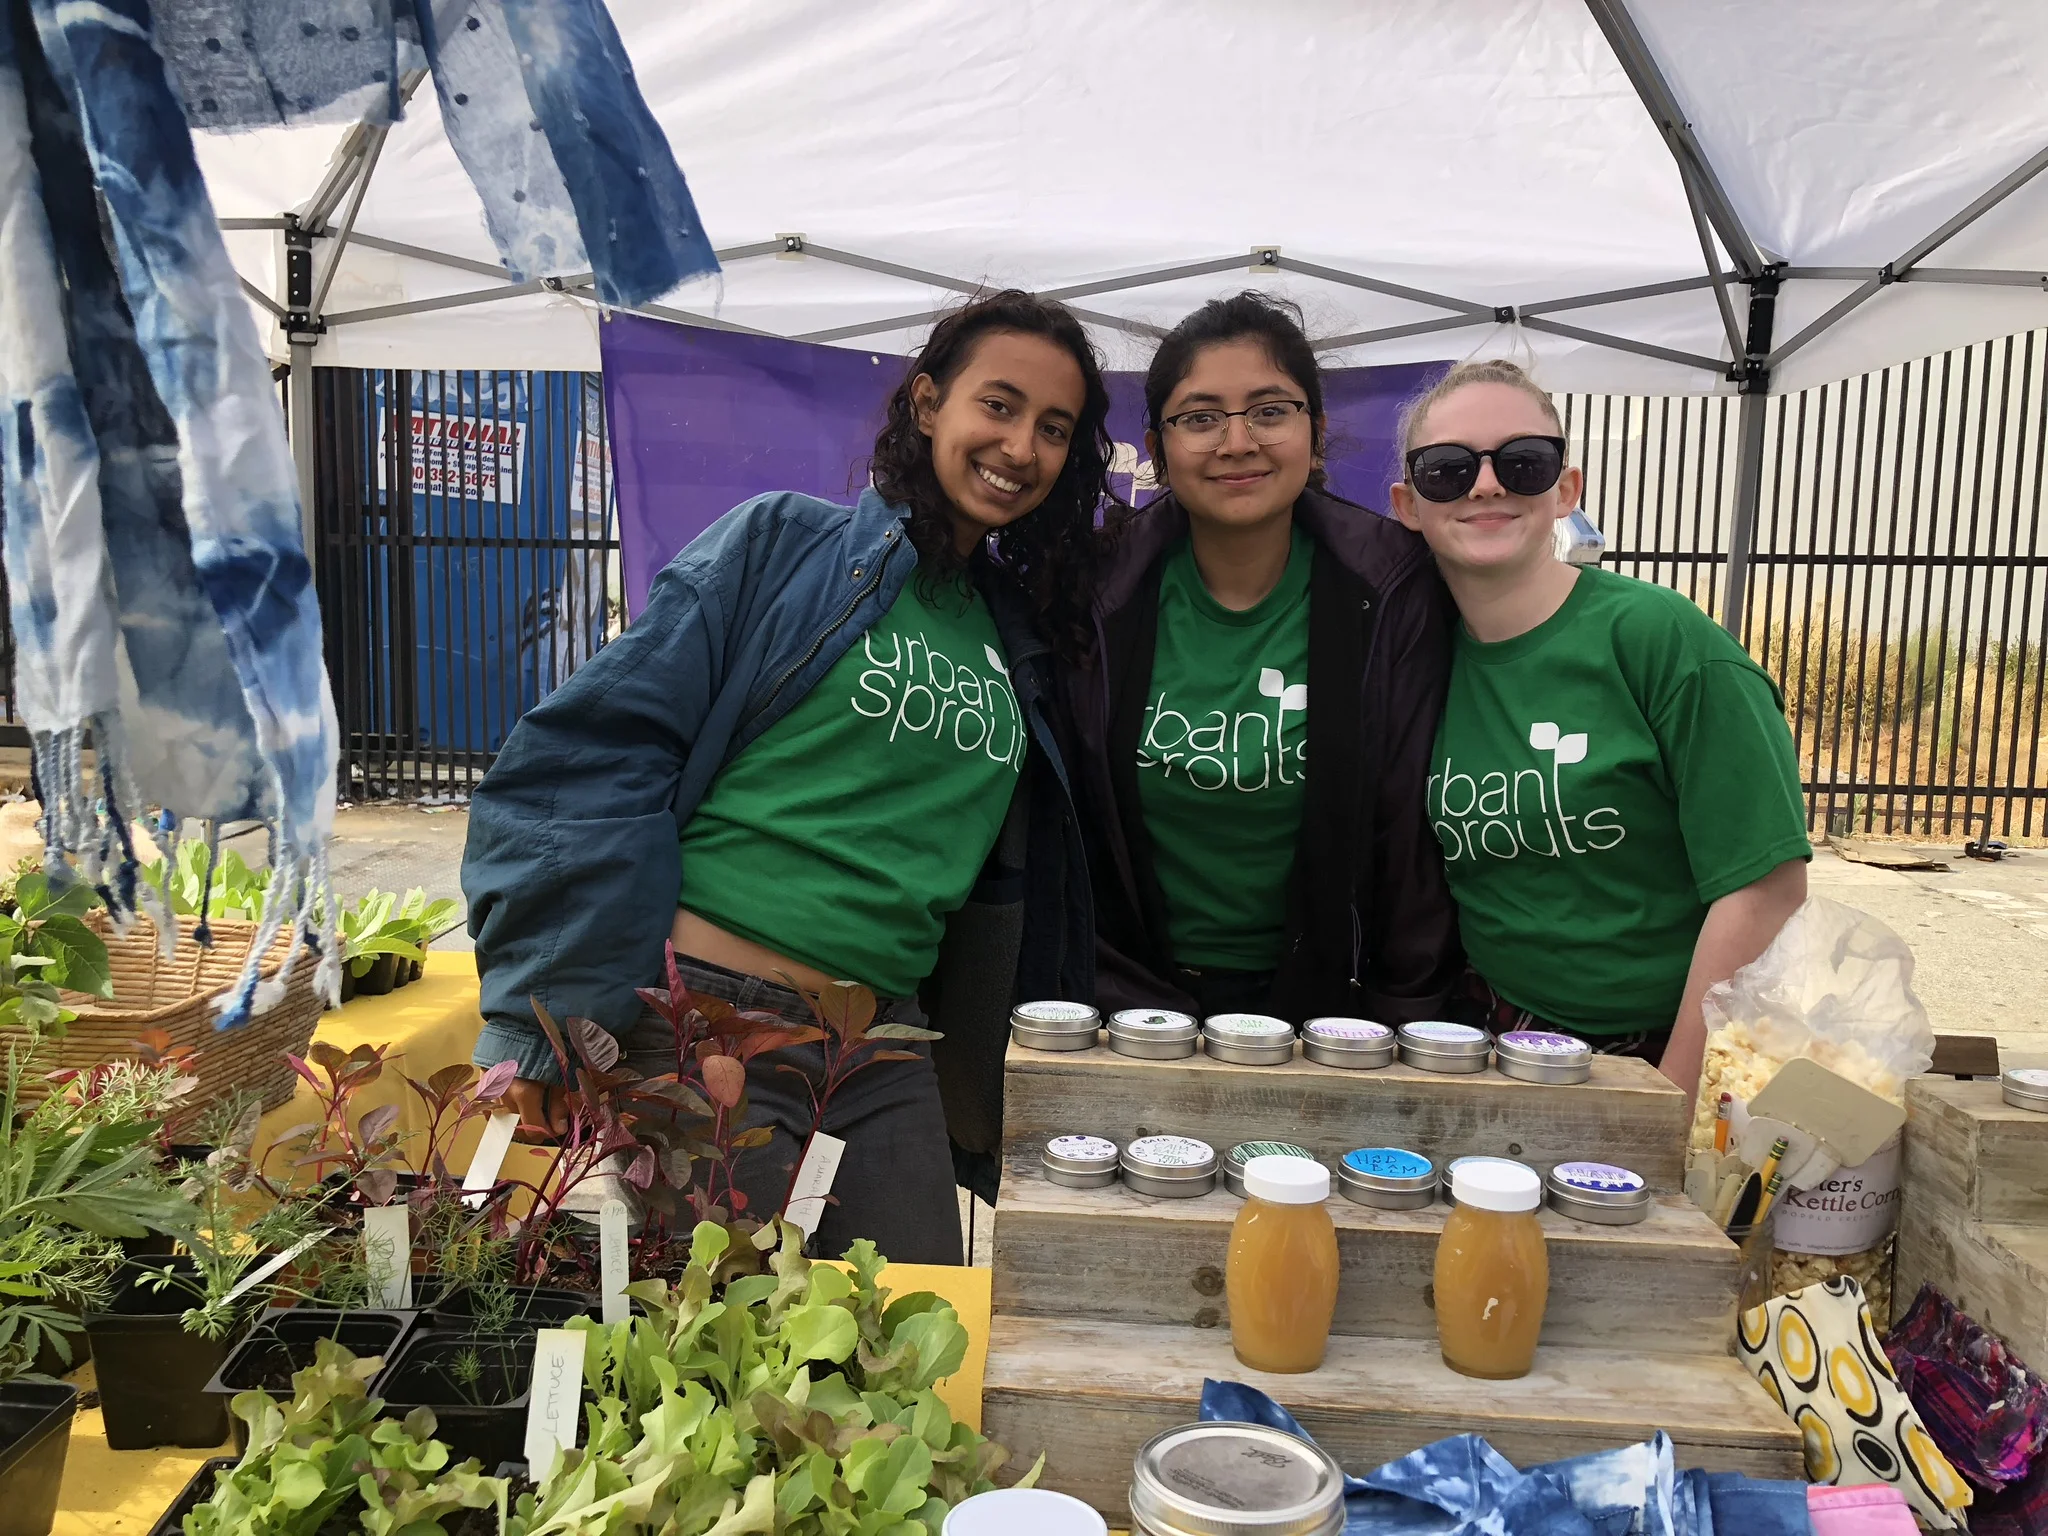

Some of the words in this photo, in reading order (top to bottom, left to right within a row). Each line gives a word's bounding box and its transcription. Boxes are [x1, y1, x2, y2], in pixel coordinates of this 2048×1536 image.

[865, 630, 1015, 720] urban
[851, 668, 1026, 773] sprout
[1144, 691, 1268, 753] ban
[1426, 757, 1547, 817] rban
[1431, 752, 1626, 864] prouts
[1782, 1187, 1857, 1212] Kettle
[542, 1354, 565, 1434] LETTUCE
